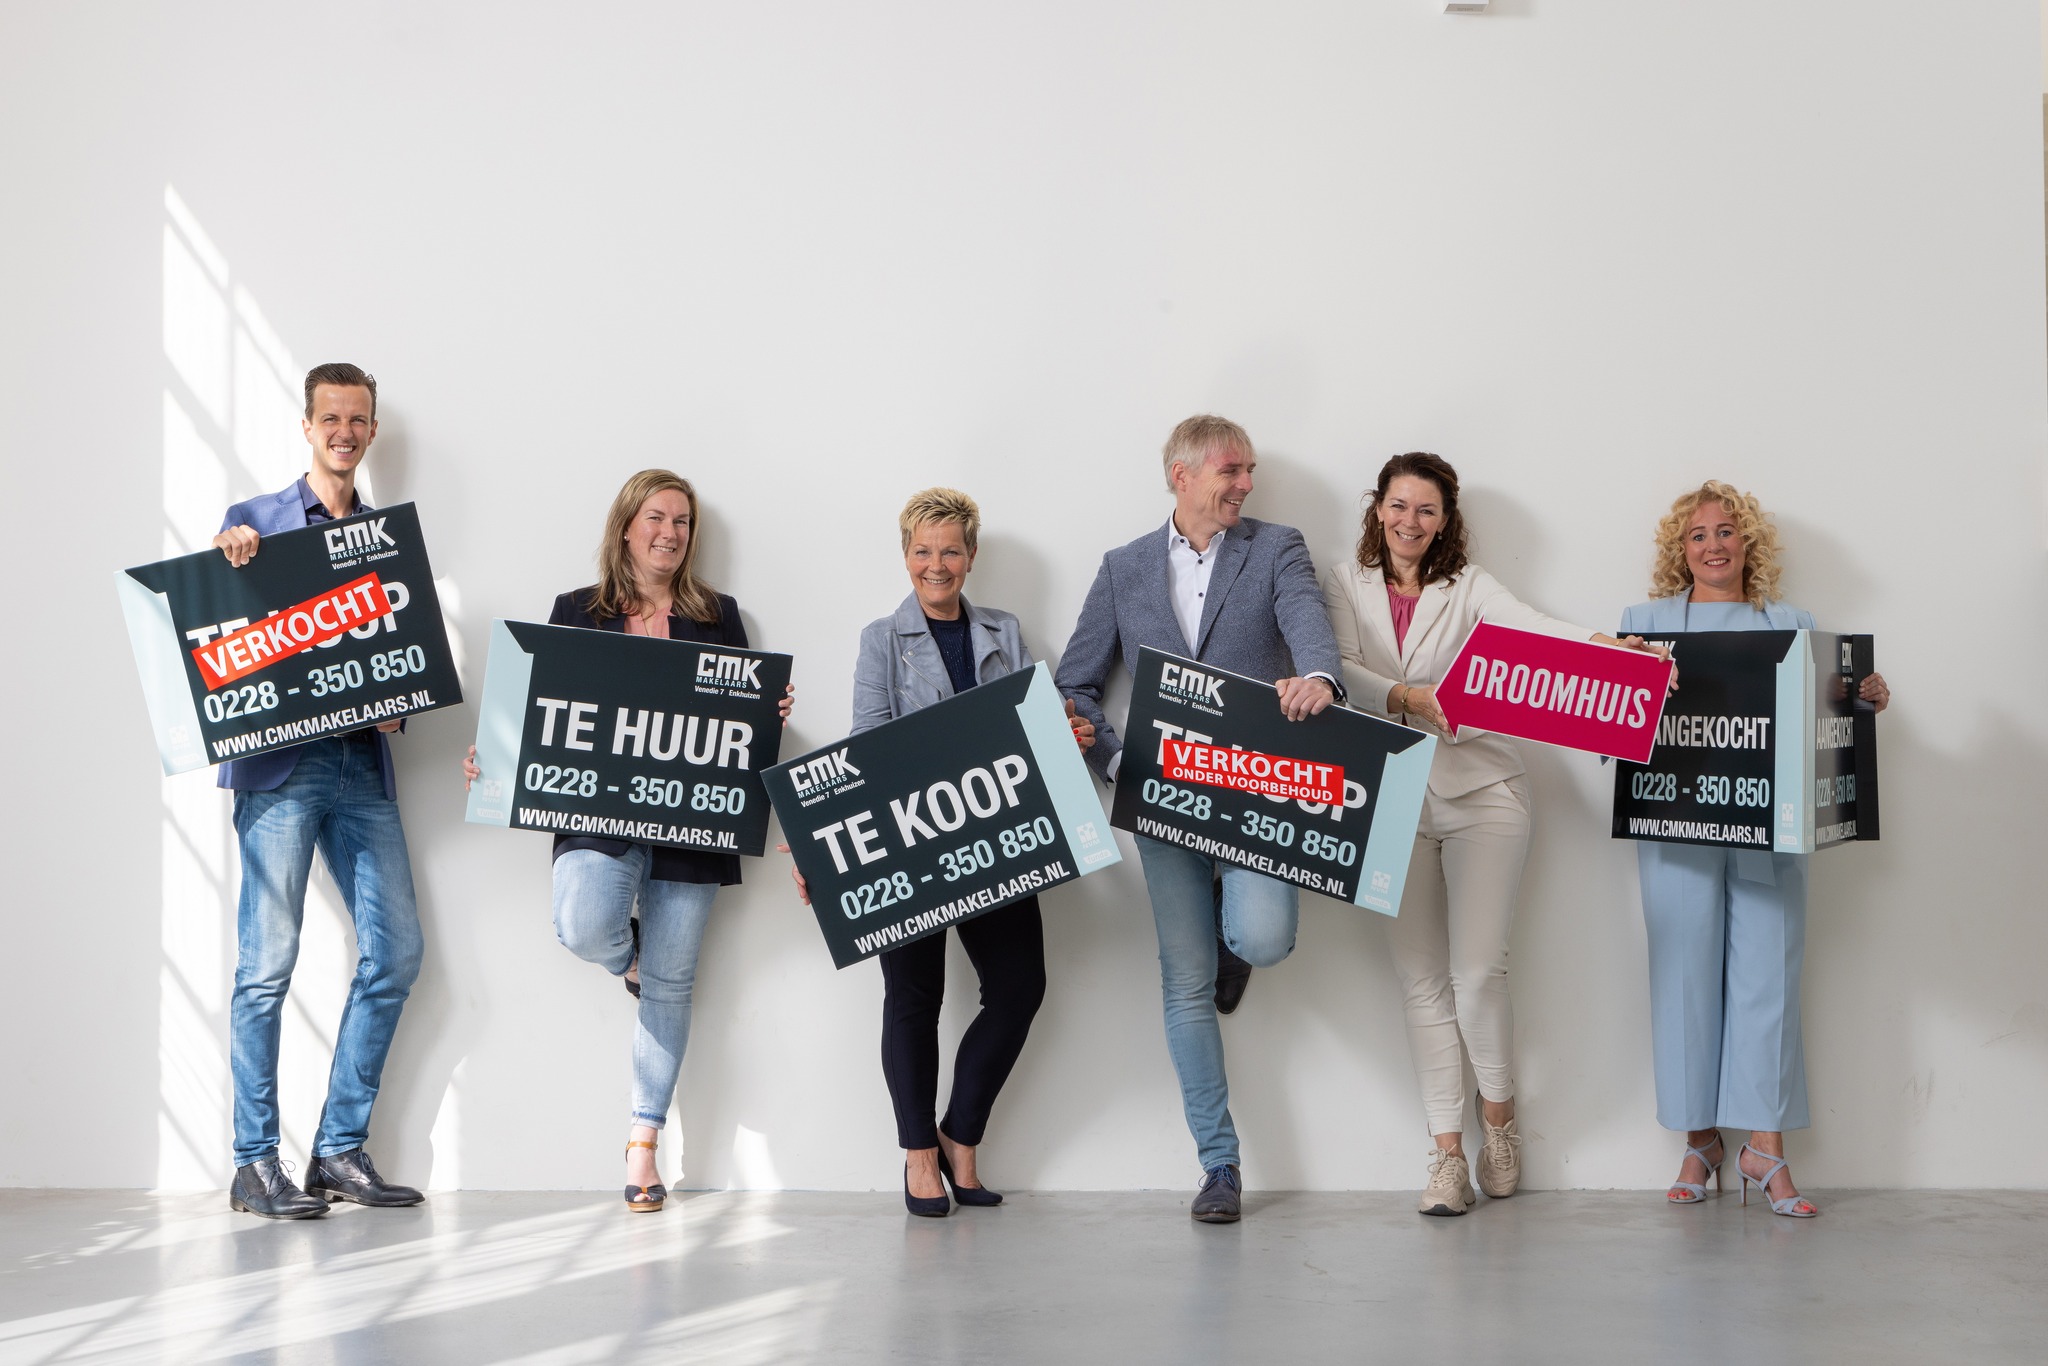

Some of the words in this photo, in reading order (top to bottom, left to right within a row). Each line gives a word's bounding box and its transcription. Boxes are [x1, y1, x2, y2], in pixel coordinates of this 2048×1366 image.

[324, 517, 396, 554] CMK
[329, 543, 382, 561] MAKELAARS
[332, 559, 357, 570] Venedie
[357, 557, 362, 565] 7
[366, 549, 399, 562] Enkhuizen
[201, 581, 377, 679] VERKOCHT
[203, 680, 280, 723] 0228
[287, 685, 300, 696] -
[307, 659, 364, 698] 350
[370, 645, 426, 682] 850
[695, 676, 748, 688] MAKELAARS
[696, 652, 763, 690] CMK
[1160, 661, 1226, 708] CMK
[694, 685, 719, 695] Venedie
[728, 689, 761, 700] Enkhuizen
[1158, 691, 1182, 704] Venedie
[1191, 702, 1223, 717] Enkhuizen
[1159, 683, 1210, 704] MAKELAARS
[1463, 654, 1652, 729] DROOMHUIS
[212, 690, 436, 758] WWW.CMKMAKELAARS.NL
[536, 697, 599, 752] TE
[611, 706, 754, 771] HUUR
[1655, 715, 1771, 750] NGEKOCHT
[788, 747, 861, 792] CMK
[1172, 743, 1333, 788] VERKOCHT
[1172, 767, 1224, 785] ONDER
[1227, 775, 1333, 801] VOORBEHOUD
[524, 763, 598, 798] 0228
[628, 775, 684, 808] 350
[690, 783, 746, 815] 850
[797, 774, 848, 799] MAKELAARS
[800, 793, 826, 808] Venedie
[833, 779, 866, 795] Enkhuizen
[1631, 771, 1677, 802] 0228
[1695, 774, 1730, 805] 350
[1734, 777, 1770, 808] 850
[1816, 777, 1831, 808] 0228
[1835, 775, 1846, 805] 350
[518, 807, 739, 850] WWW.CMKMAKELAARS.NL
[812, 810, 888, 875] TE
[889, 754, 1029, 848] KOOP
[1142, 778, 1212, 821] 0228
[1220, 811, 1233, 823] -
[1241, 810, 1295, 847] 350
[1301, 830, 1357, 867] 850
[1629, 817, 1769, 845] WWW.CMKMAKELAARS.NL
[840, 871, 914, 920] 0228
[920, 873, 933, 883] -
[938, 839, 995, 882] 350
[998, 815, 1055, 859] 850
[1136, 816, 1348, 897] WWW.CMKMAKELAARS.NL
[854, 860, 1070, 954] WWW.CMKMAKELAARS.NL
